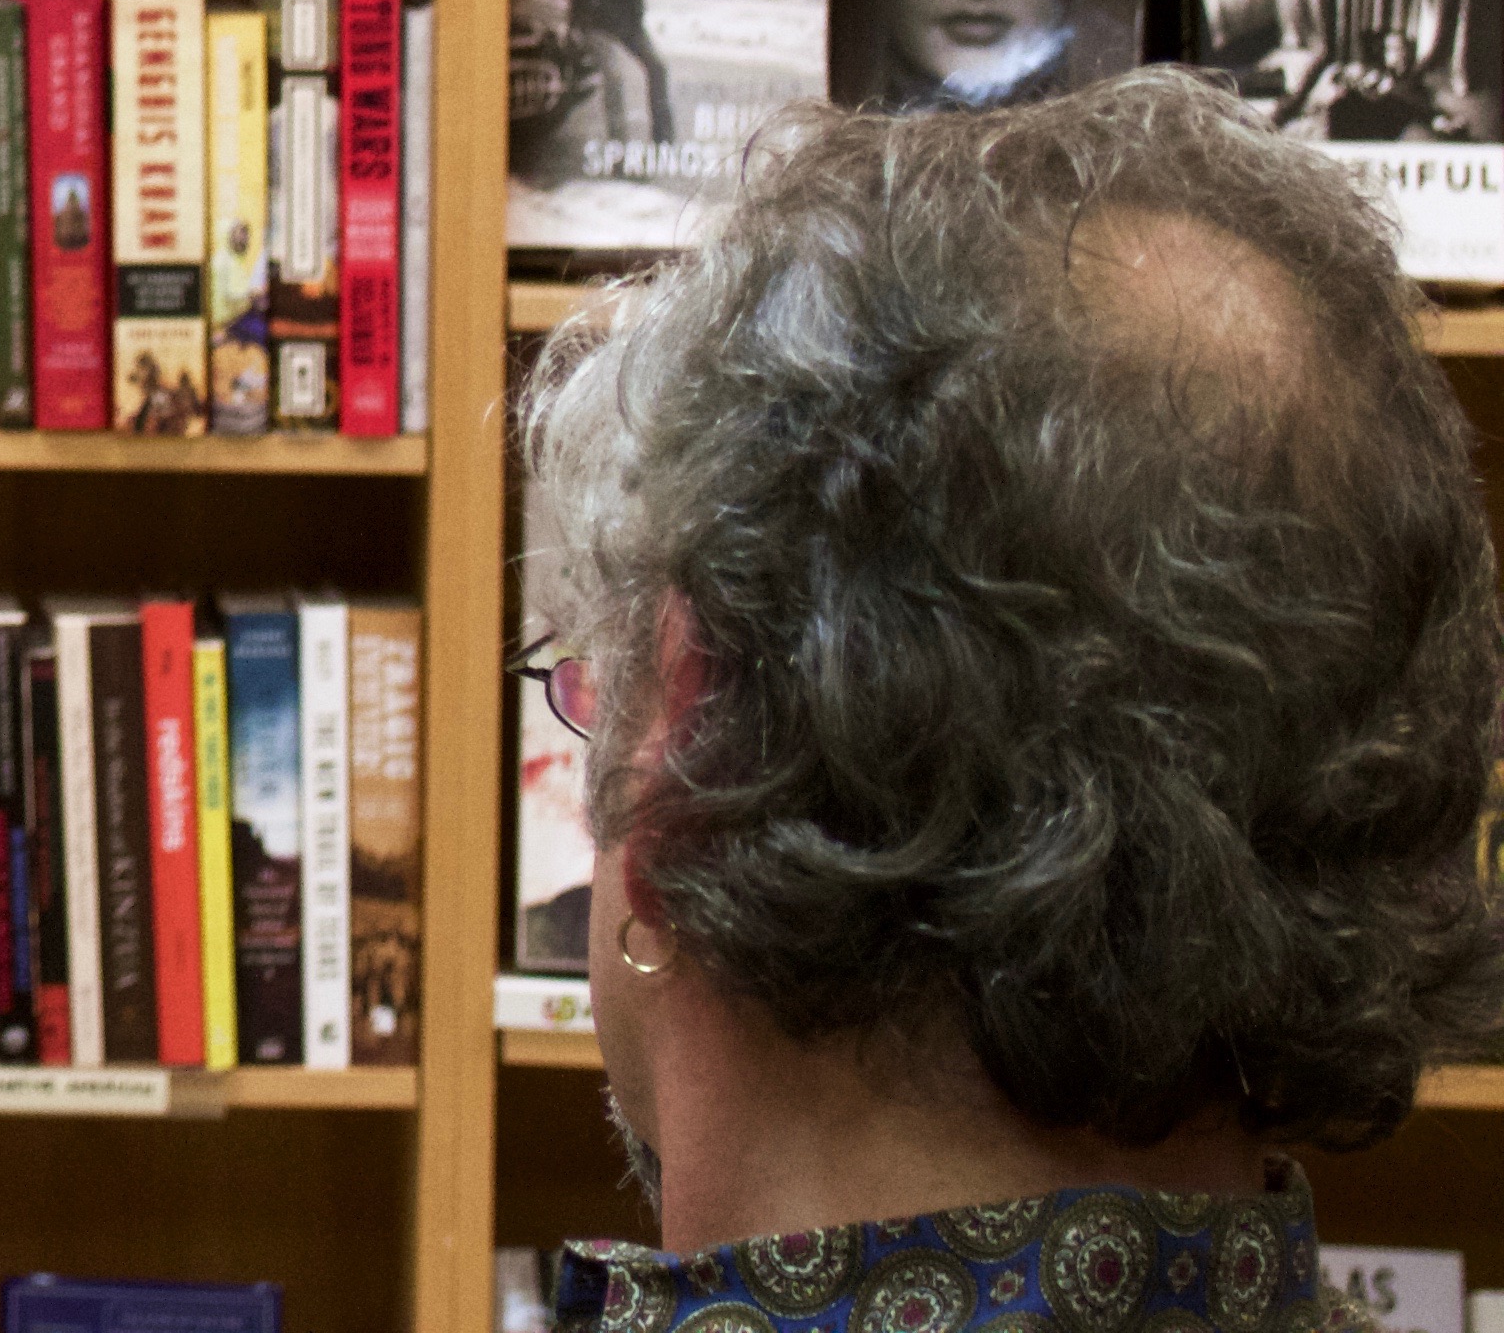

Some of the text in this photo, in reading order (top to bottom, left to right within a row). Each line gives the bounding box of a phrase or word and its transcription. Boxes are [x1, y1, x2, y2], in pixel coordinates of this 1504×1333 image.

[136, 6, 180, 252] GENGHIS KHAN
[350, 84, 393, 180] WARS
[157, 717, 185, 853] redskins
[314, 812, 338, 872] TRAIL
[108, 855, 139, 992] KINZUA
[314, 915, 338, 984] TEARS
